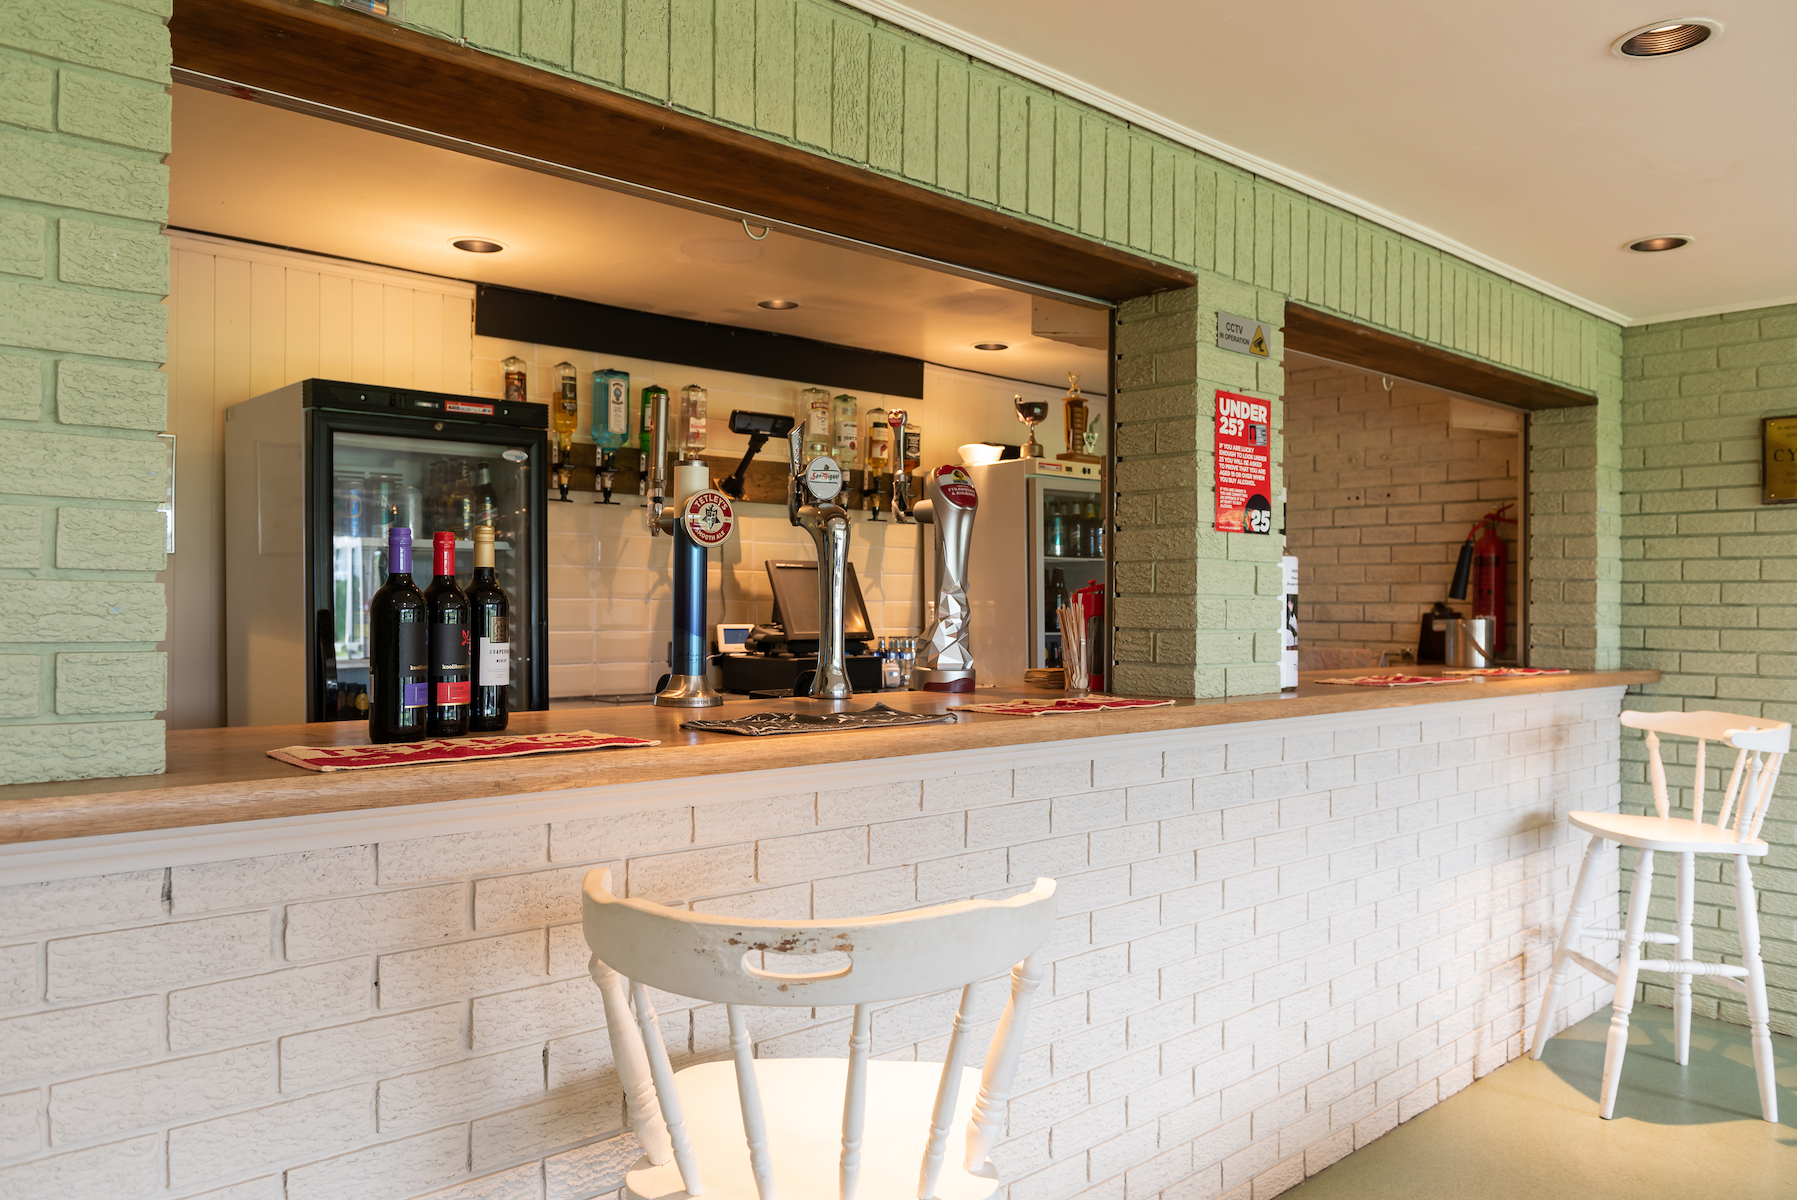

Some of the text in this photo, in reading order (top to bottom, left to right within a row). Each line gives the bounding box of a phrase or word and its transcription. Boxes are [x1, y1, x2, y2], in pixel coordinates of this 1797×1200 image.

[1226, 322, 1243, 334] CCTV
[1225, 333, 1249, 345] OPERATION
[1219, 397, 1267, 423] UNDER
[1219, 416, 1245, 437] 25?
[694, 494, 728, 510] TETLEY'S
[1251, 509, 1270, 532] 25
[695, 529, 725, 541] SMOOTH ALE
